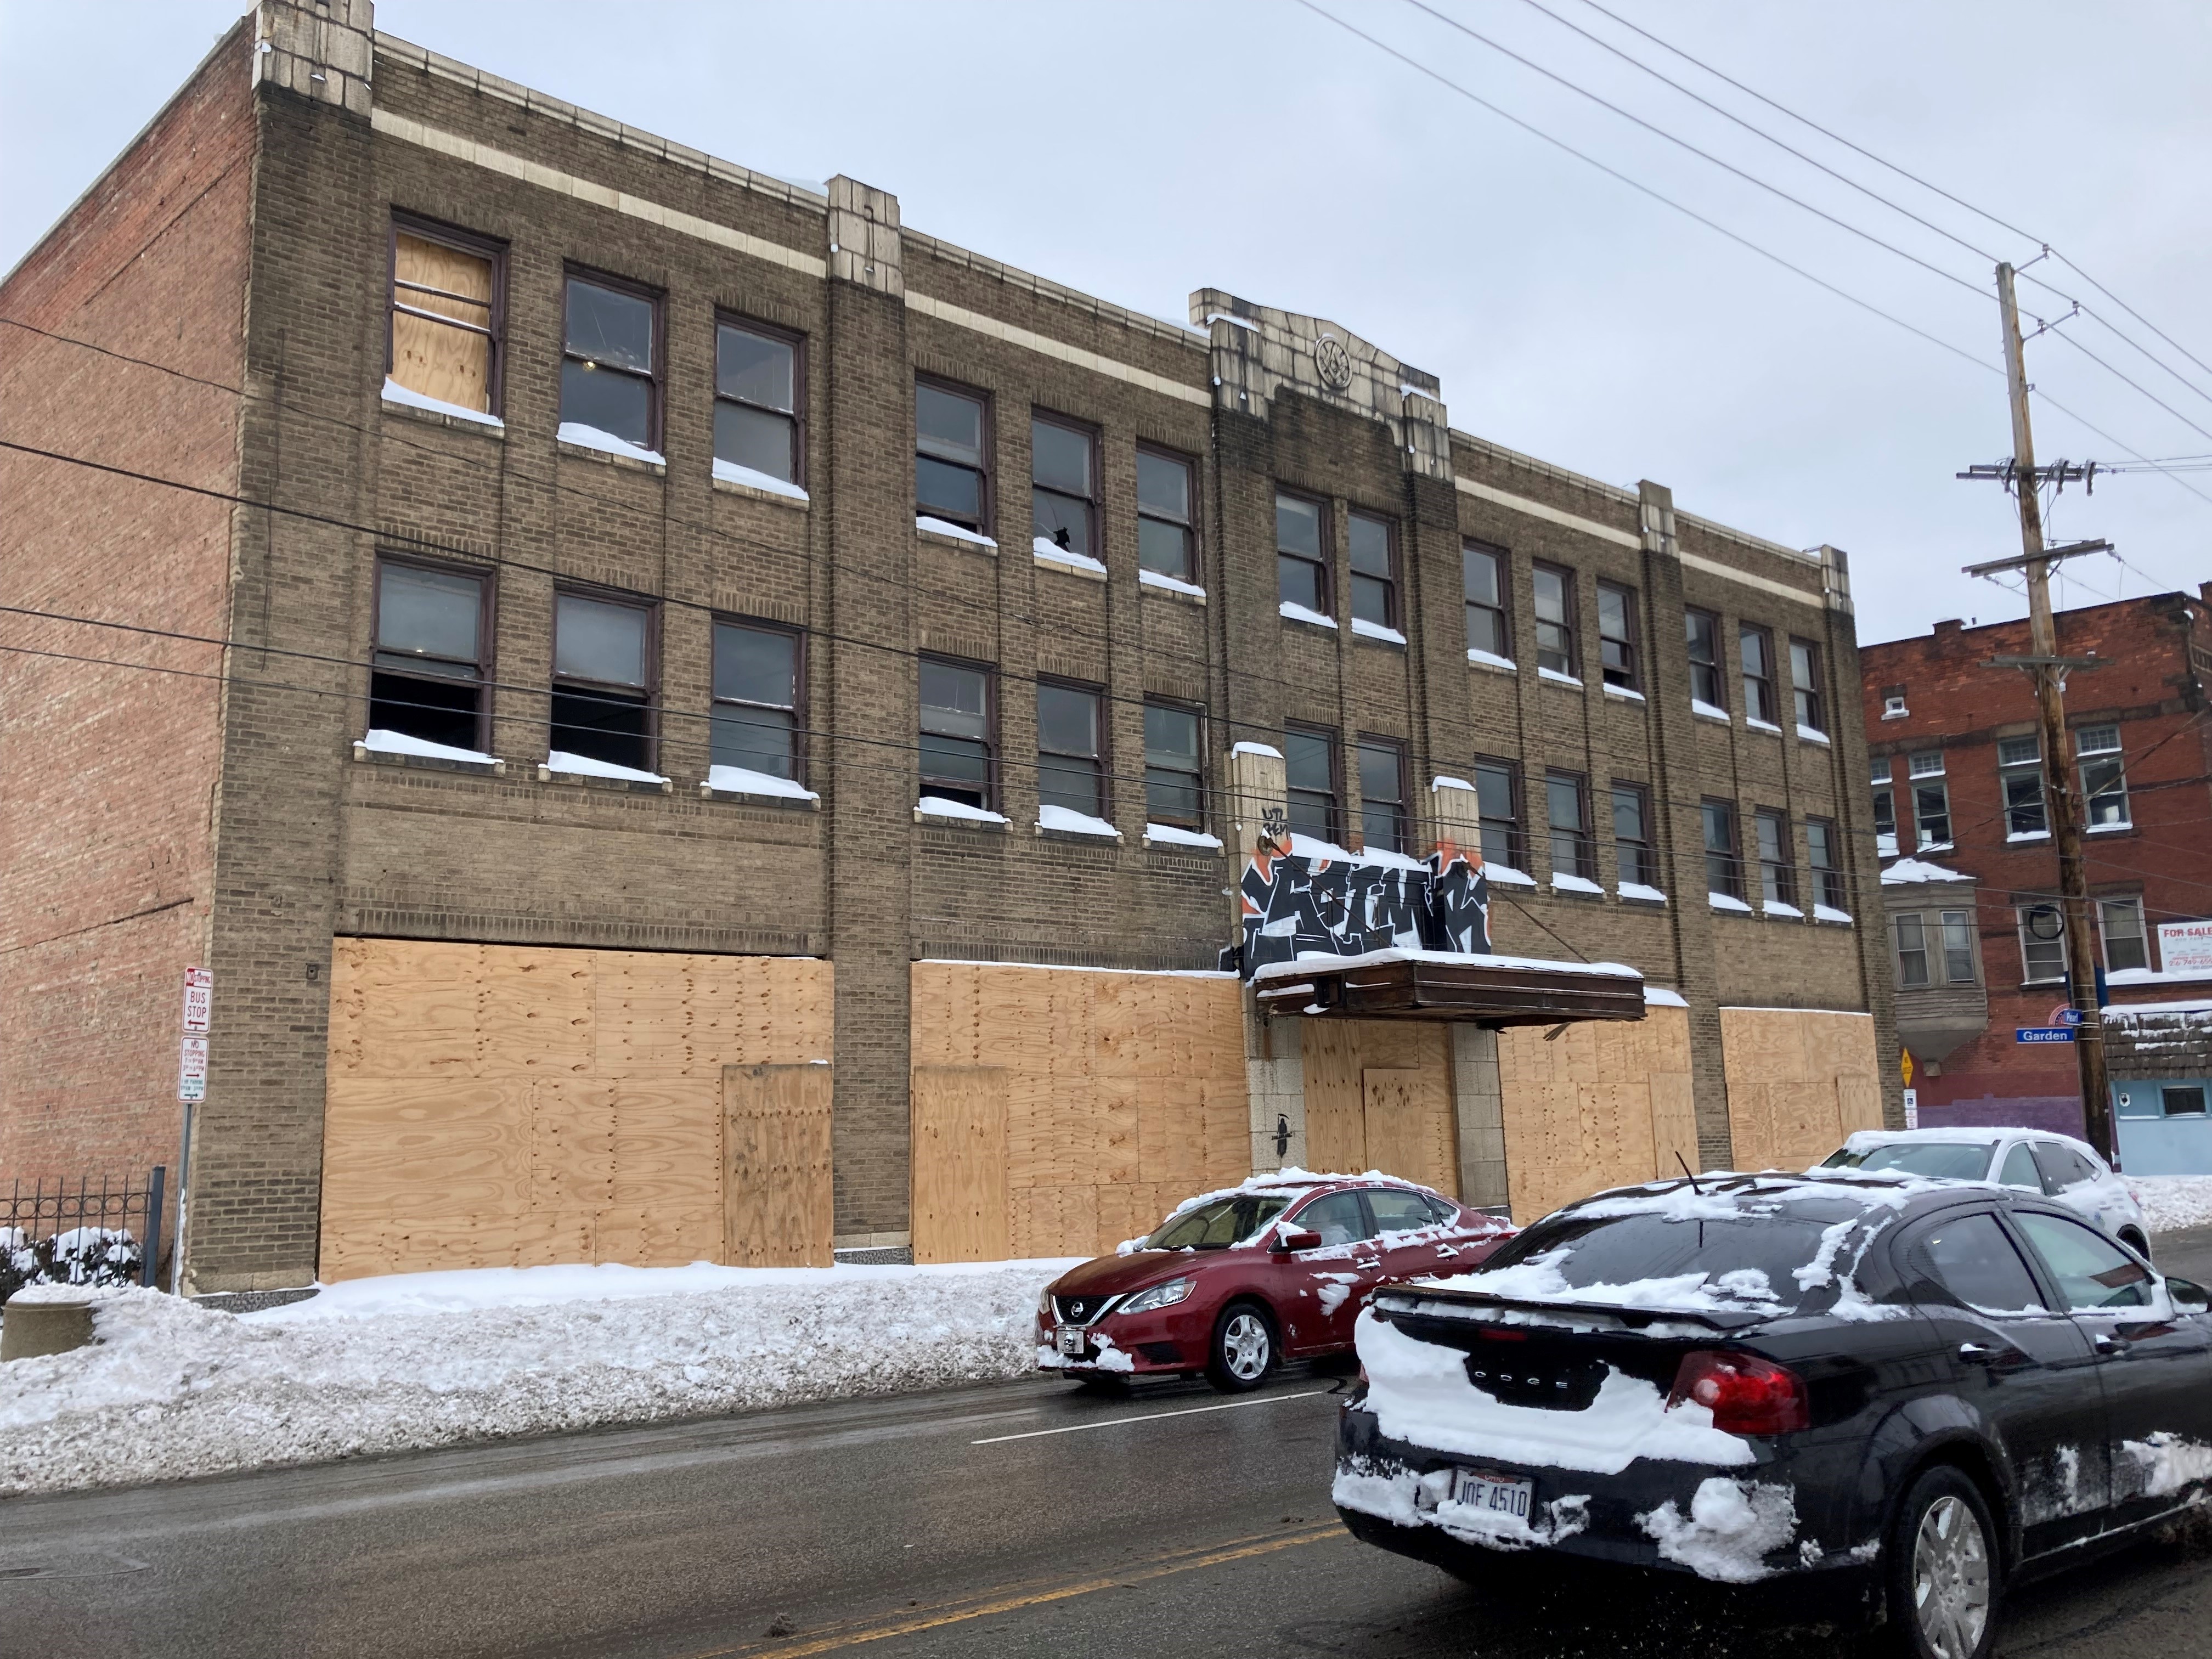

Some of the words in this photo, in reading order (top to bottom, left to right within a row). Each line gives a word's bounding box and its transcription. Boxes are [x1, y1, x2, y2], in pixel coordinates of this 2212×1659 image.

[2164, 929, 2184, 938] FOR
[2187, 927, 2212, 936] SALE
[187, 971, 194, 984] NO
[190, 991, 205, 1003] BUS
[187, 1006, 206, 1018] STOP
[2066, 1012, 2078, 1023] Pearl
[2023, 1030, 2068, 1041] Garden
[191, 1041, 199, 1049] NO
[184, 1049, 205, 1057] STOPPING
[1474, 1371, 1568, 1389] ODGE
[1489, 1486, 1527, 1517] 4510
